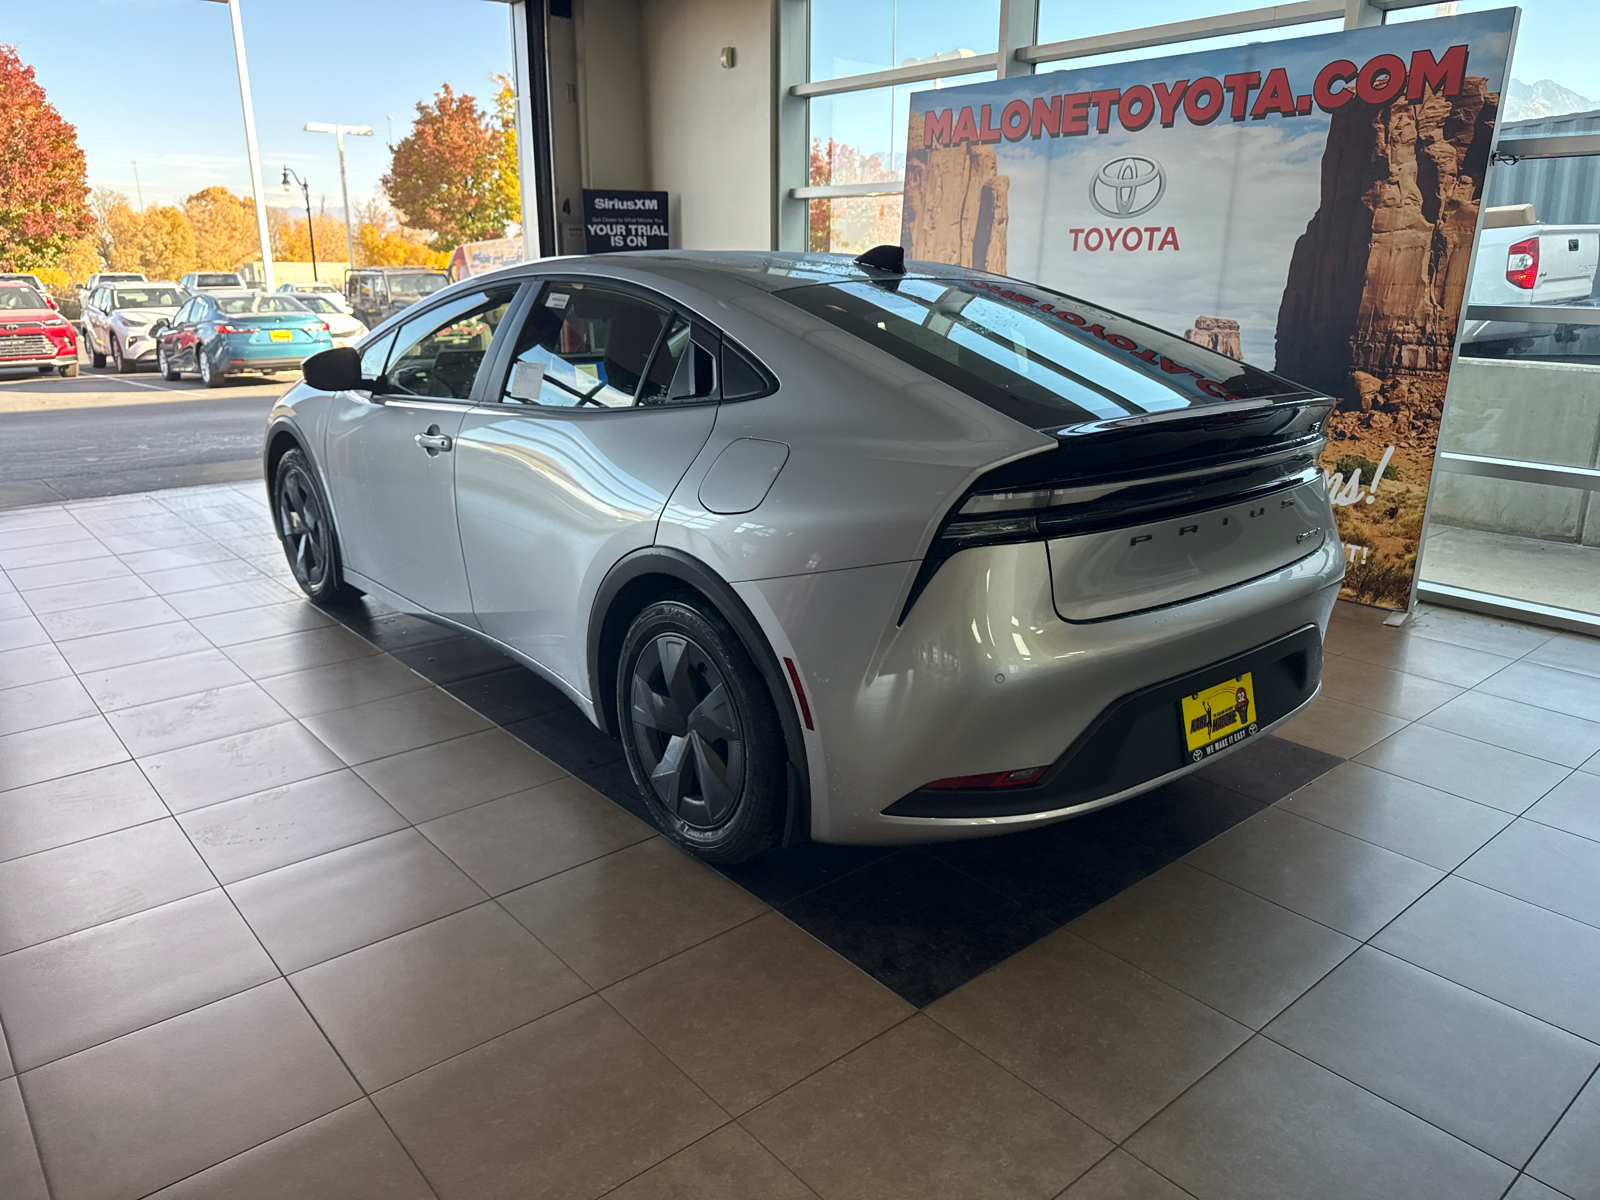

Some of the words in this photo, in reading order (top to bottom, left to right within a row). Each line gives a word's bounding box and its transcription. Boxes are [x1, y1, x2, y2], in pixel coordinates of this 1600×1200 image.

[923, 44, 1469, 148] MALONETOYOTA.COM
[562, 198, 571, 216] 4
[594, 198, 658, 210] SiriusXM
[587, 224, 626, 236] YOUR
[628, 225, 669, 237] TRIAL
[1069, 226, 1180, 252] TOYOTA
[610, 236, 624, 247] IS
[626, 236, 648, 247] ON
[1130, 498, 1294, 547] PRIUS
[1238, 692, 1245, 702] 32
[1206, 746, 1214, 754] WE
[1215, 738, 1228, 750] MAKE
[1229, 735, 1234, 744] IT
[1235, 730, 1246, 742] EASY
